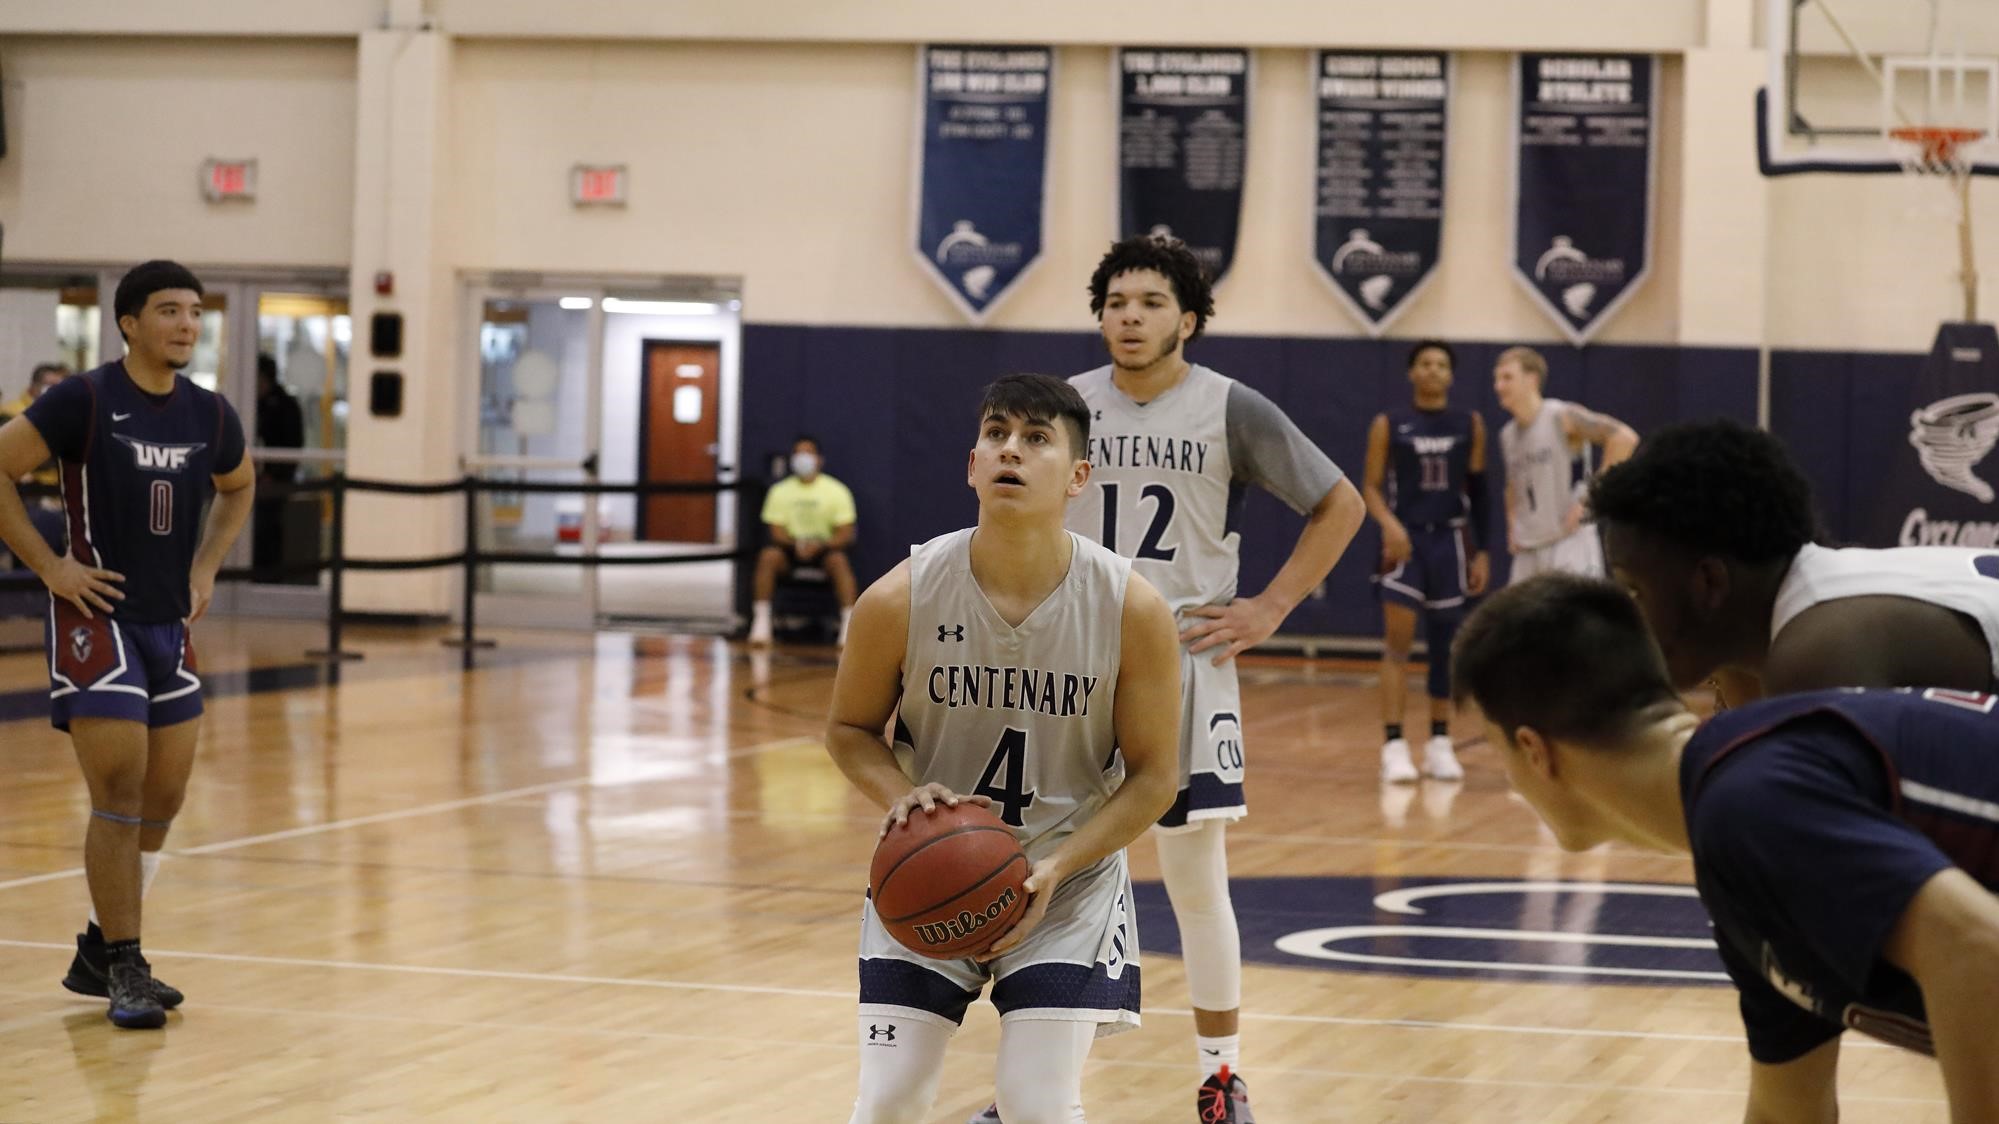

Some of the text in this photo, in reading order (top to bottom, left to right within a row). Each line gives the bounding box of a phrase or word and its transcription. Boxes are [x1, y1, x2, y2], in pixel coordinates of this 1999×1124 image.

[129, 440, 195, 471] UVF
[1087, 435, 1208, 475] ENTENARY
[150, 479, 173, 535] 0
[1096, 482, 1179, 563] 12
[928, 665, 1098, 717] CENTENARY
[972, 726, 1036, 828] 4
[912, 886, 1018, 946] Wilson
